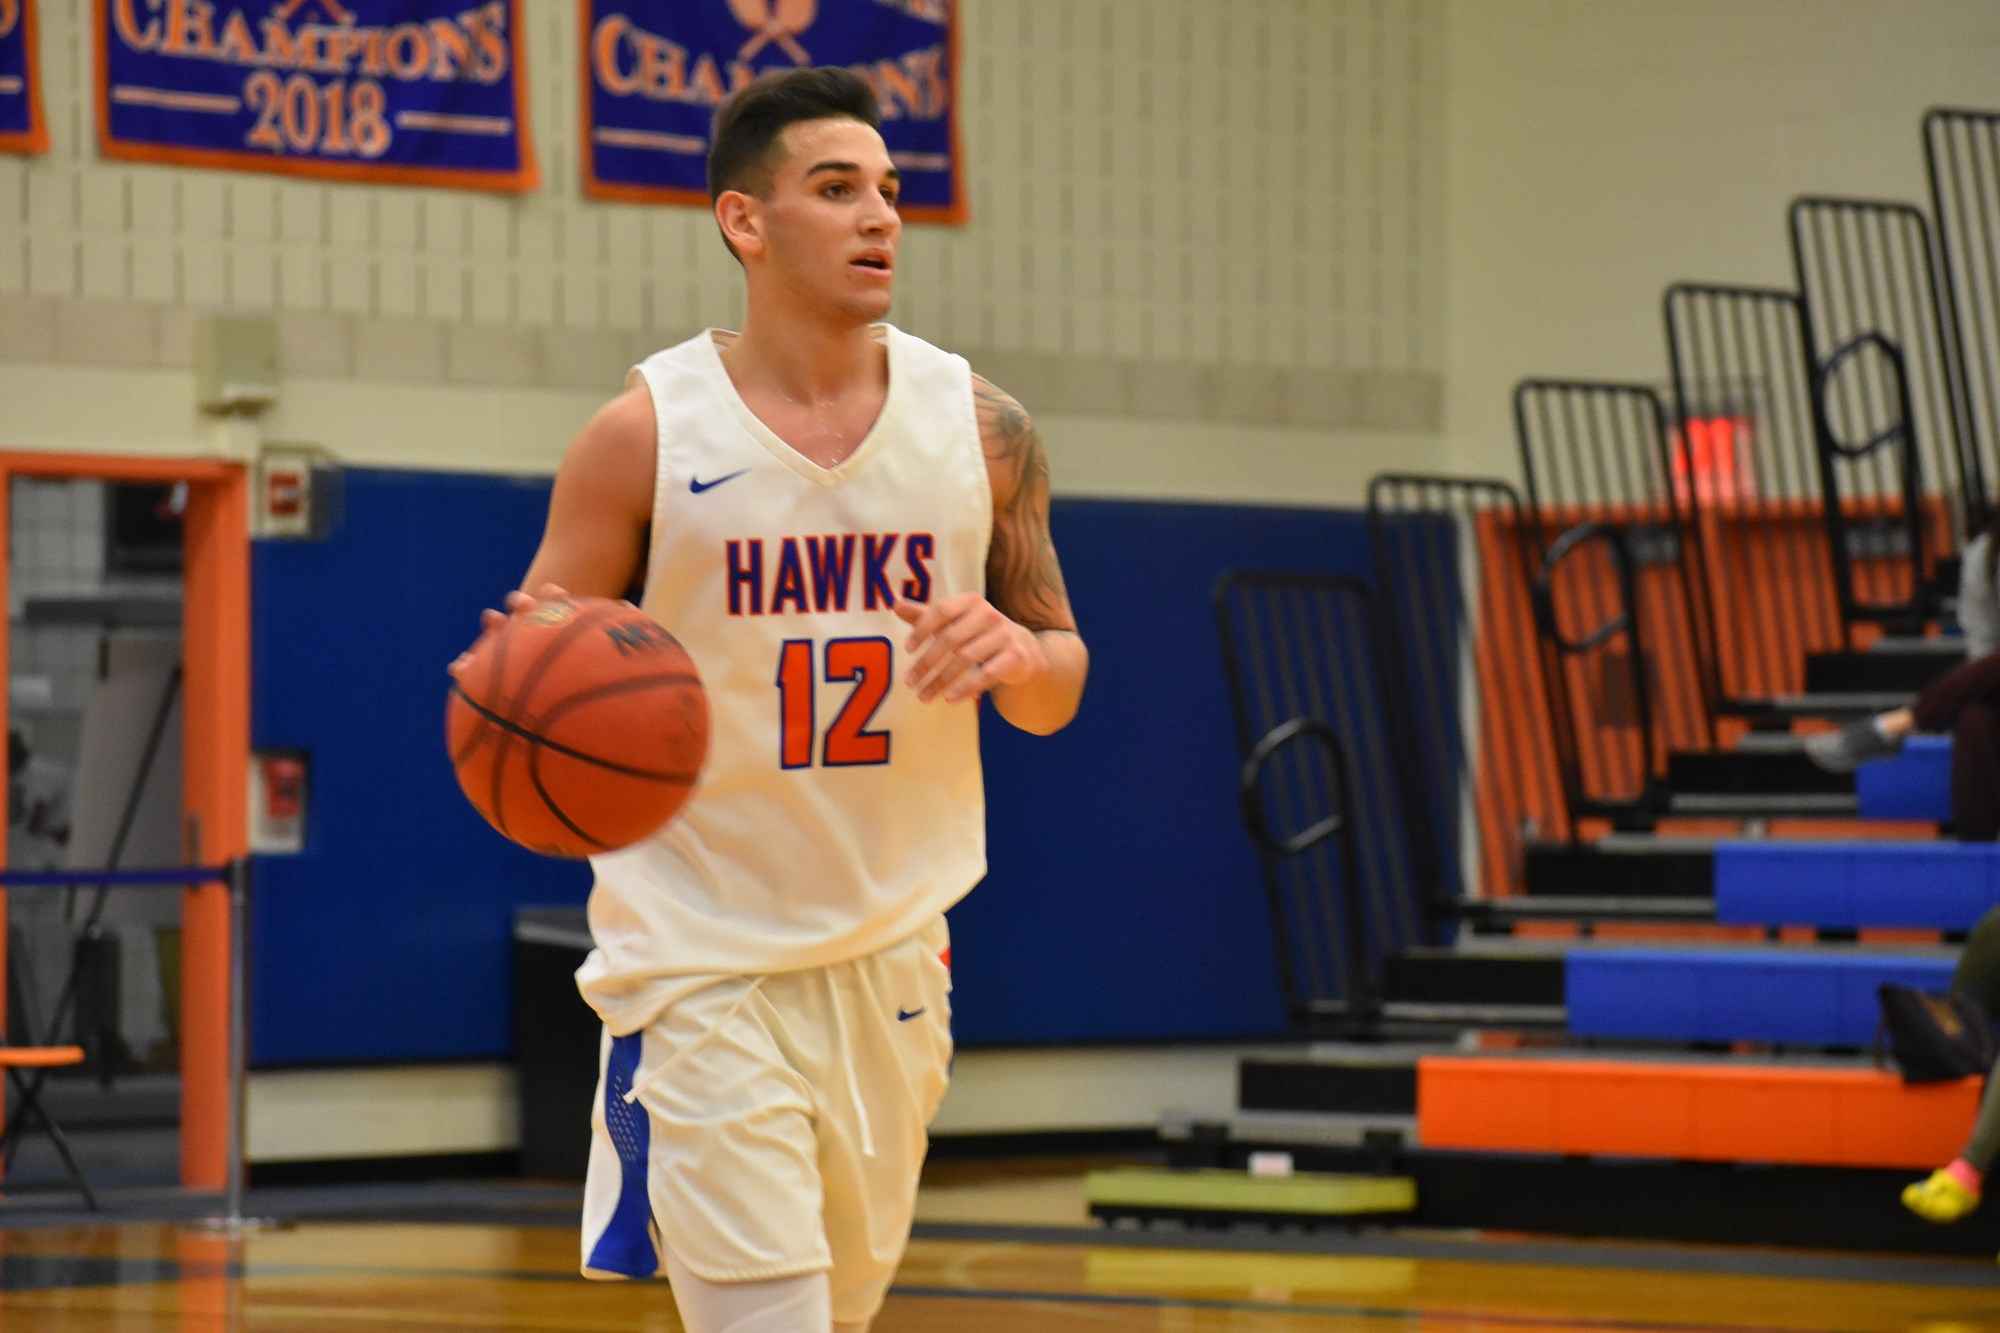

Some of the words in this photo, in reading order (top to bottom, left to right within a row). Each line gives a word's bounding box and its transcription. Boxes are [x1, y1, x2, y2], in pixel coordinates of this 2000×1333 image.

[113, 0, 507, 85] CHAMPIONS
[592, 13, 946, 119] CHANS
[243, 70, 391, 157] 2018
[725, 532, 935, 616] HAWKS
[775, 635, 893, 770] 12
